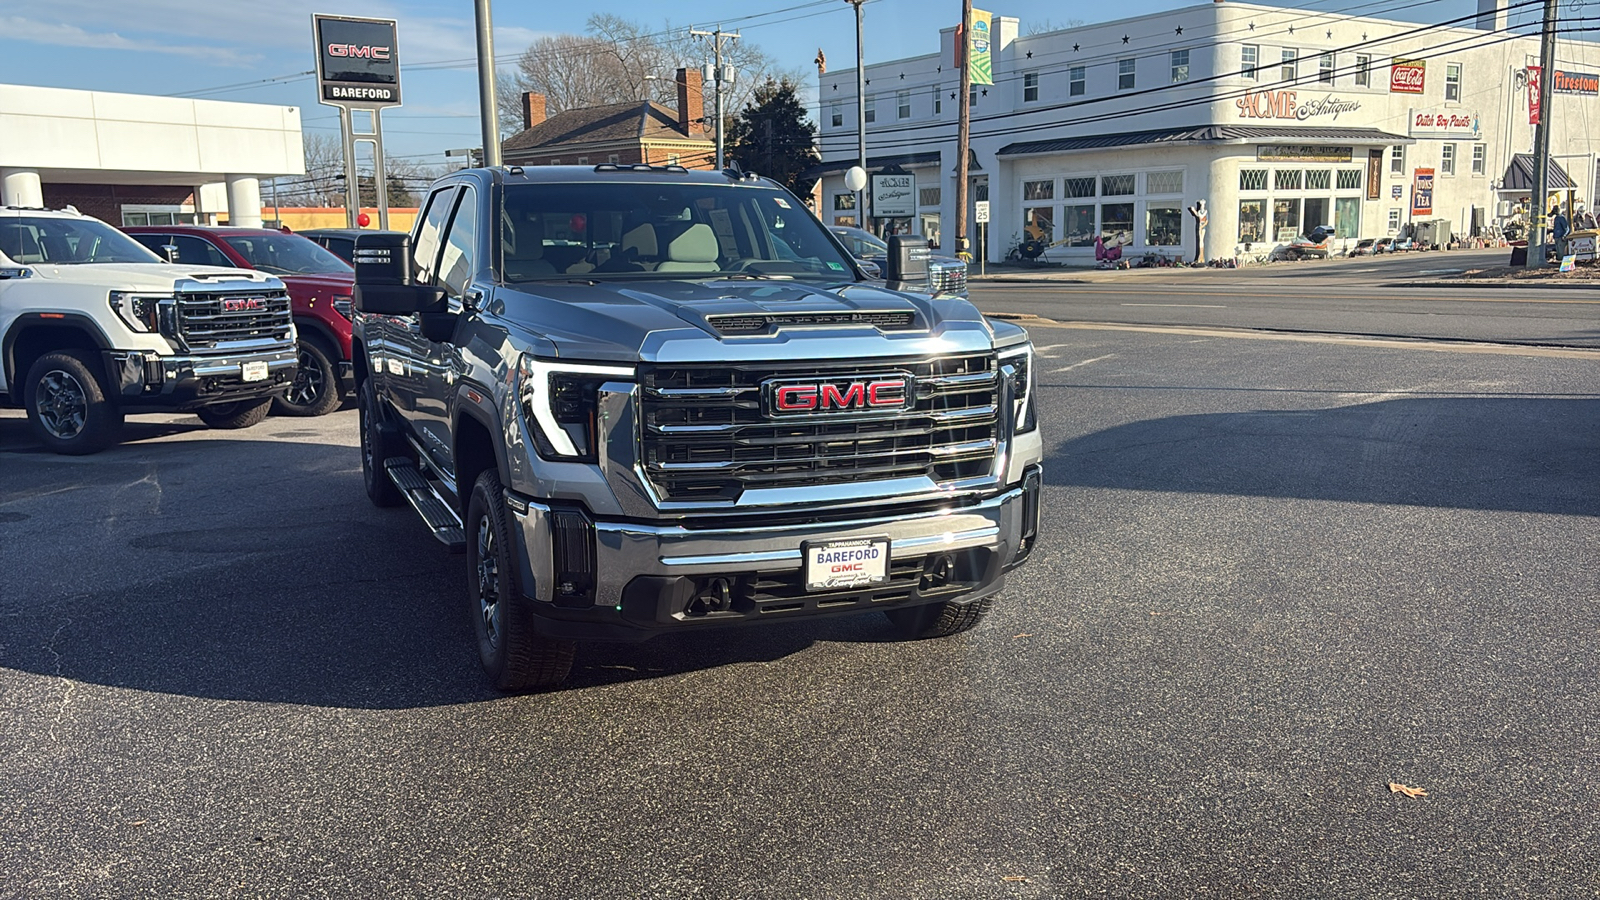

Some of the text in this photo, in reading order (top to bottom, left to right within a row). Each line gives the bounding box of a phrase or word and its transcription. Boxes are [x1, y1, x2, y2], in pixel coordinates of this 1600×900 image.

[328, 43, 390, 59] GMC
[1554, 71, 1598, 91] Firestone
[332, 87, 391, 99] BAREFORD
[1236, 88, 1297, 119] ACME
[1415, 113, 1471, 130] Dutch Boy Paints
[880, 178, 910, 188] ACME
[1416, 194, 1430, 206] TEA
[977, 212, 988, 220] 25
[226, 299, 265, 311] GMC
[777, 381, 905, 411] GMC
[828, 540, 871, 549] TAPPAHANNOCK
[817, 548, 879, 564] BAREFORD
[831, 563, 863, 573] GMC
[825, 574, 872, 588] Bareford
